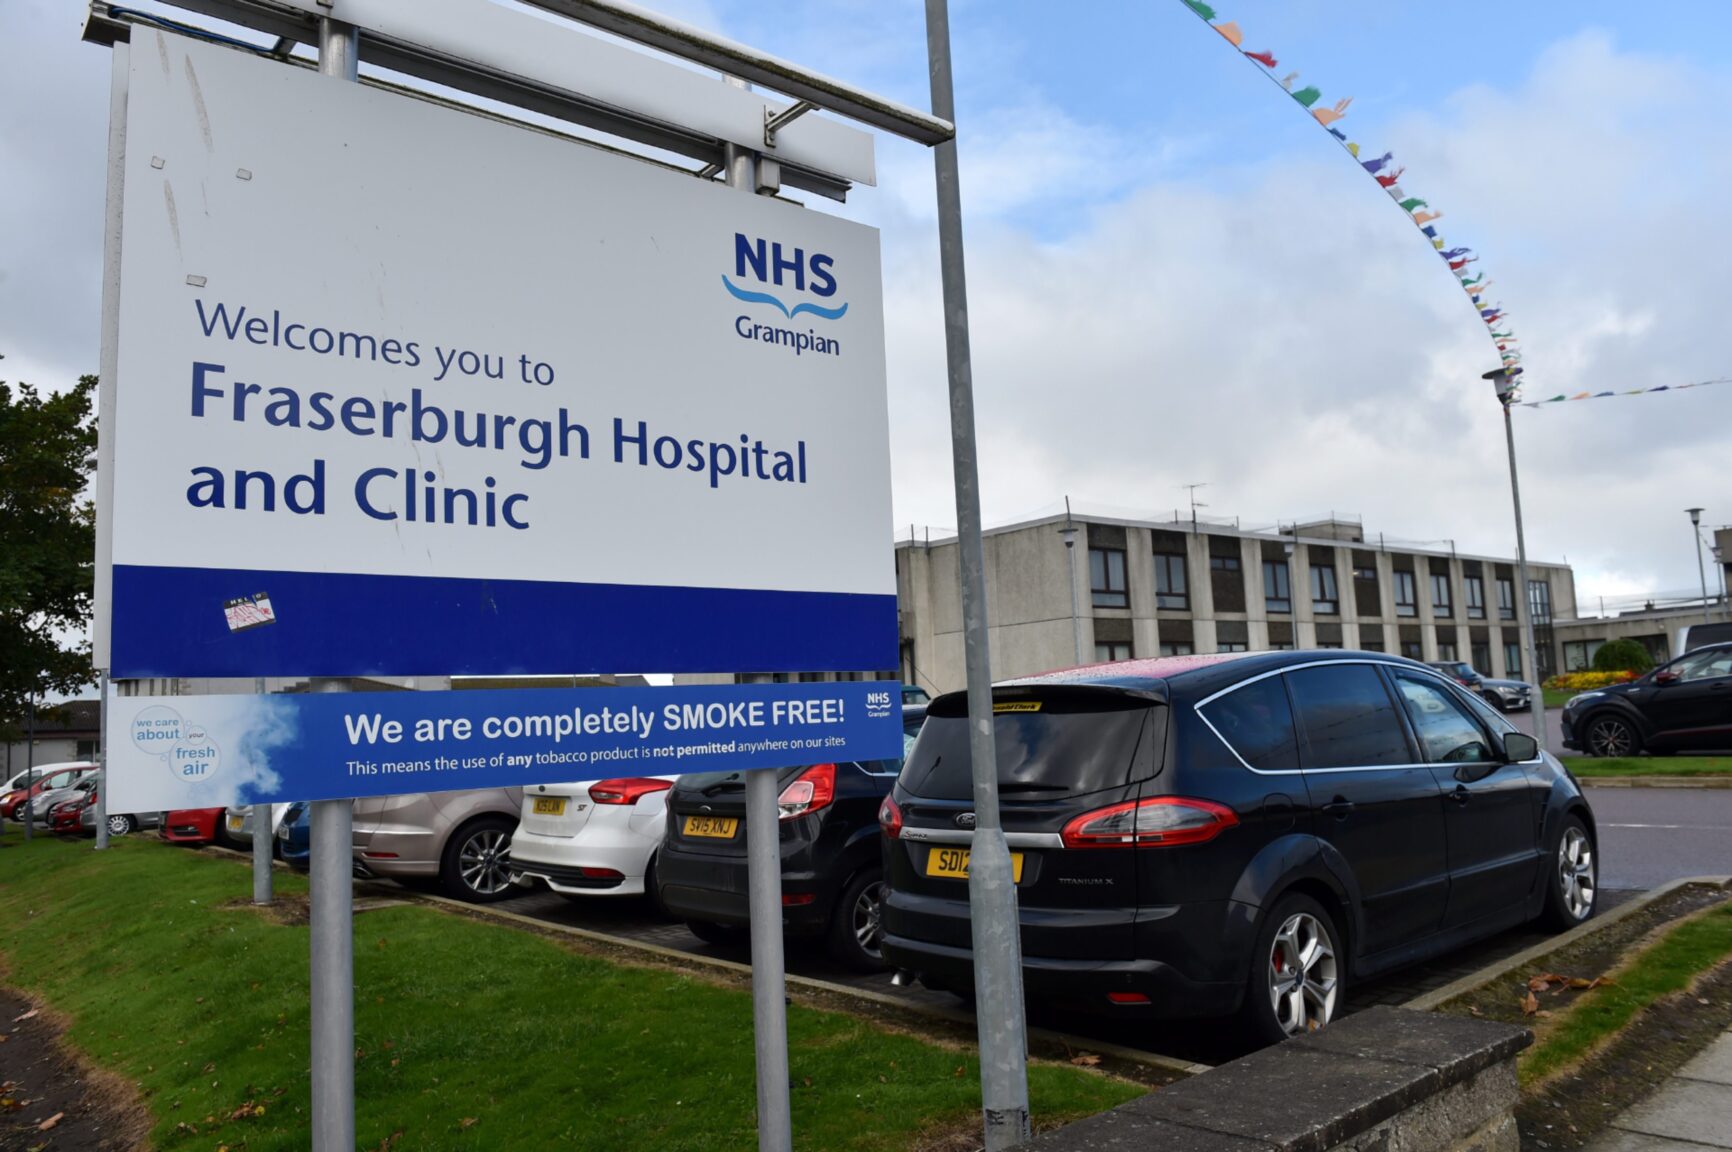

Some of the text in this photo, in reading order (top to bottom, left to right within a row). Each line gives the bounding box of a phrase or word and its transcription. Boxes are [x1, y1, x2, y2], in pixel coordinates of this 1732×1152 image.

[735, 232, 837, 297] NHS
[194, 299, 555, 386] Welcomes you to
[735, 315, 840, 356] Grampian
[191, 361, 807, 488] Fraserburgh Hospital
[186, 459, 530, 530] and Clinic
[867, 692, 890, 704] NHS
[136, 719, 180, 727] we care
[136, 728, 180, 741] about
[344, 699, 845, 745] We are completely SMOKE FREE!
[175, 746, 216, 759] fresh
[182, 760, 209, 775] air
[346, 735, 846, 776] This means the use of any tobacco product is not permitted anywhere on our sites
[1058, 877, 1104, 885] TITANIUM
